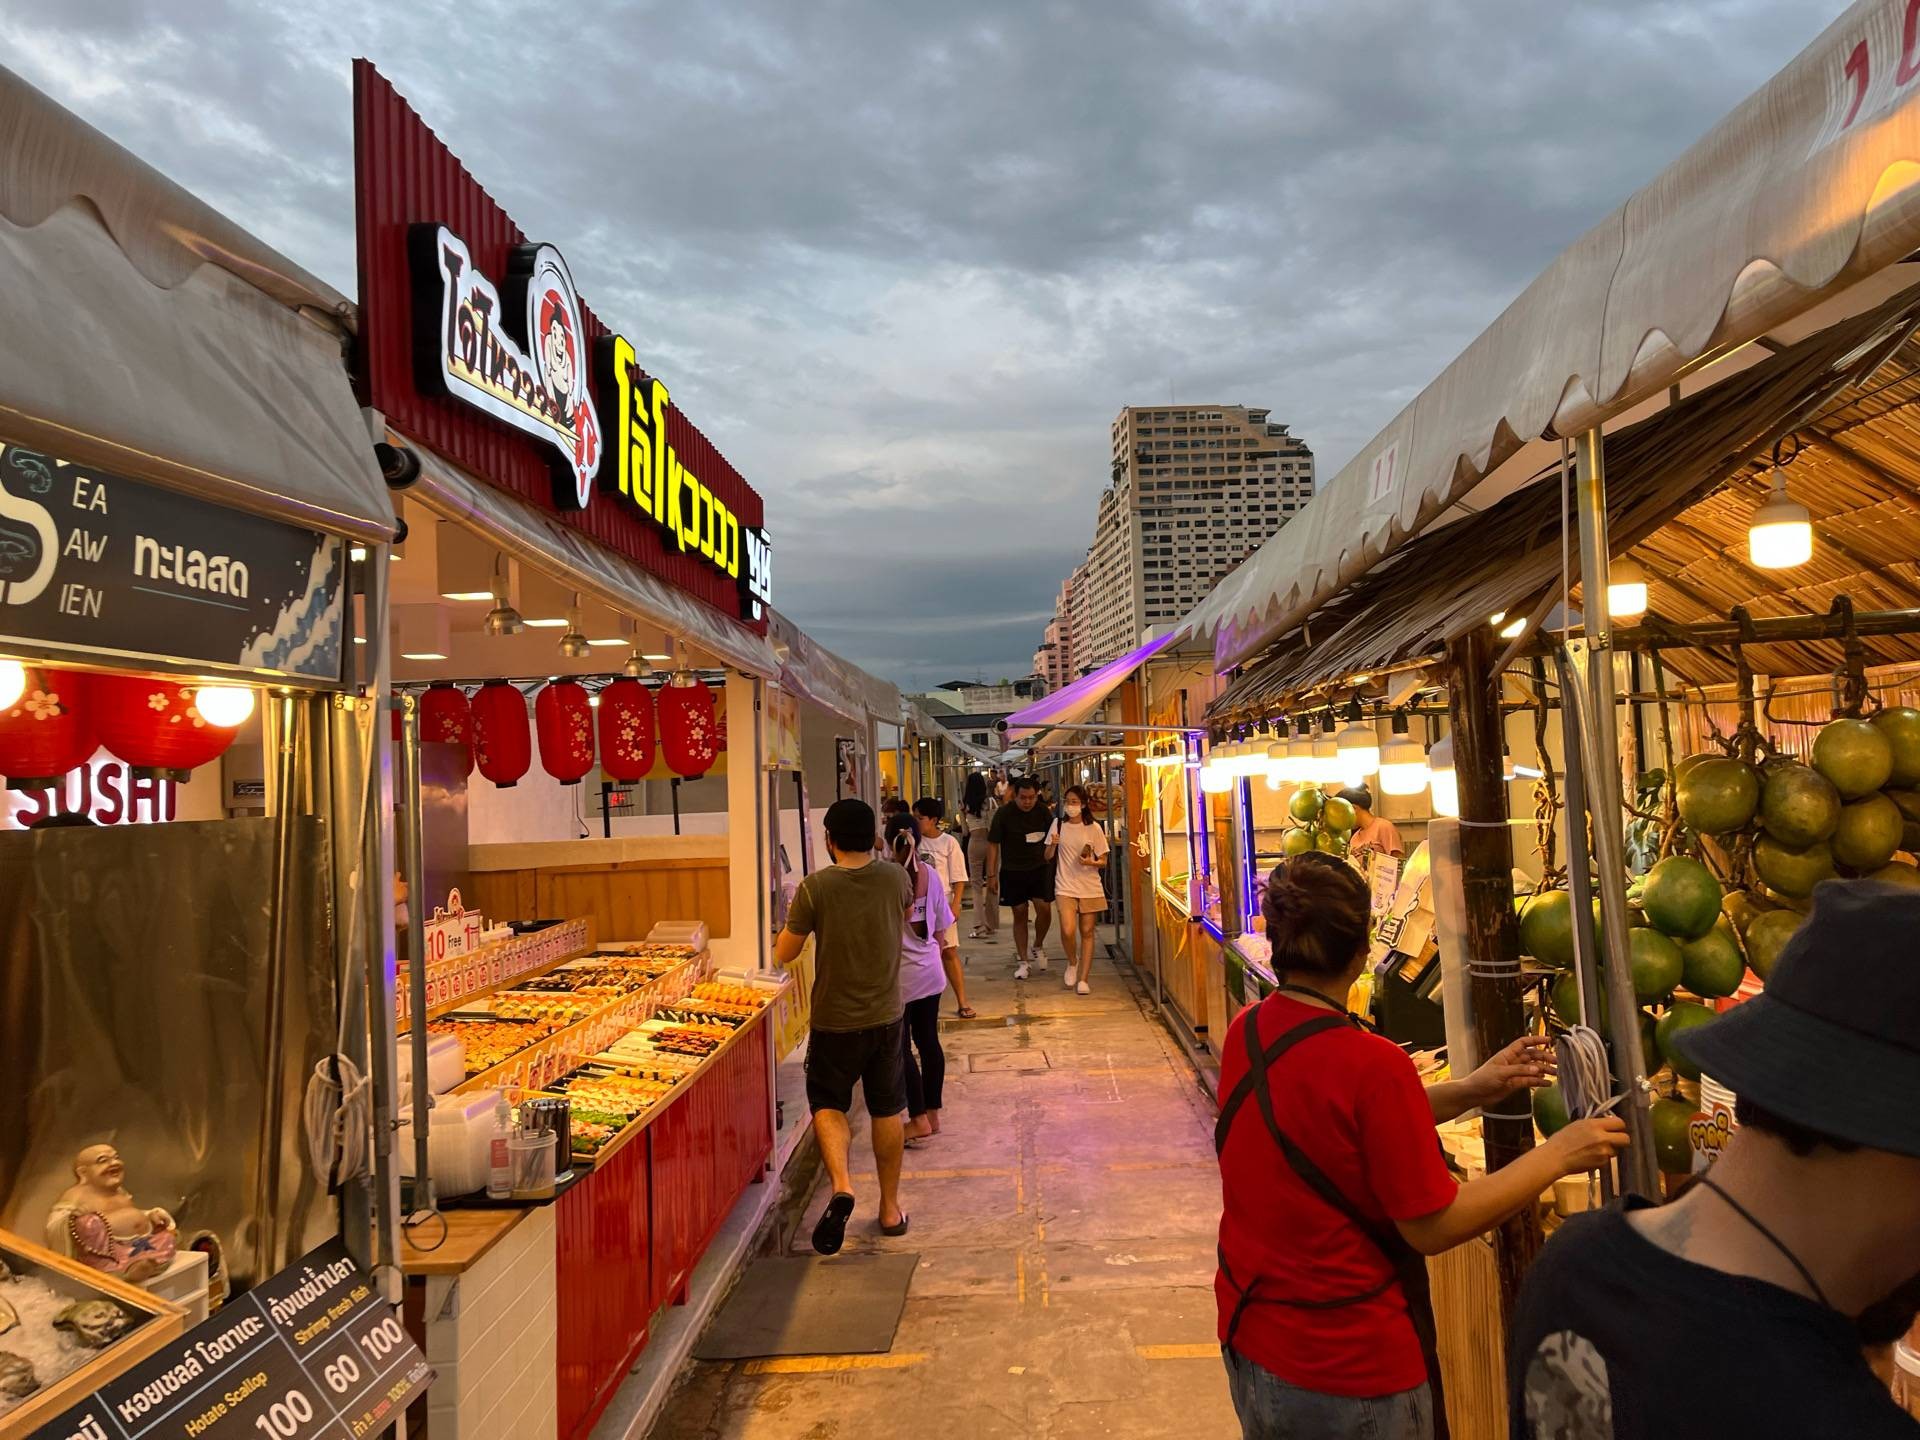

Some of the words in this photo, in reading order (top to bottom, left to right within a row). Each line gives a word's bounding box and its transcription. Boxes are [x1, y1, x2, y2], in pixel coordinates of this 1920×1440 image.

[614, 336, 739, 579] โอ้โหวววว
[1374, 447, 1396, 500] 11
[72, 476, 108, 515] EA
[63, 527, 108, 562] AW
[134, 534, 249, 599] ทะเลสด
[58, 583, 103, 618] IEN
[16, 762, 176, 828] SUSHI
[427, 929, 445, 962] 10
[448, 934, 462, 949] Free
[266, 1256, 357, 1327] กุ้งแช่น้ำปลา
[293, 1315, 331, 1346] Shrimp
[360, 1317, 404, 1361] 100
[116, 1348, 204, 1424] หอยเชลล์
[323, 1354, 360, 1394] 60
[184, 1402, 228, 1439] Hotate
[224, 1370, 269, 1408] Scallop
[255, 1389, 314, 1440] 100
